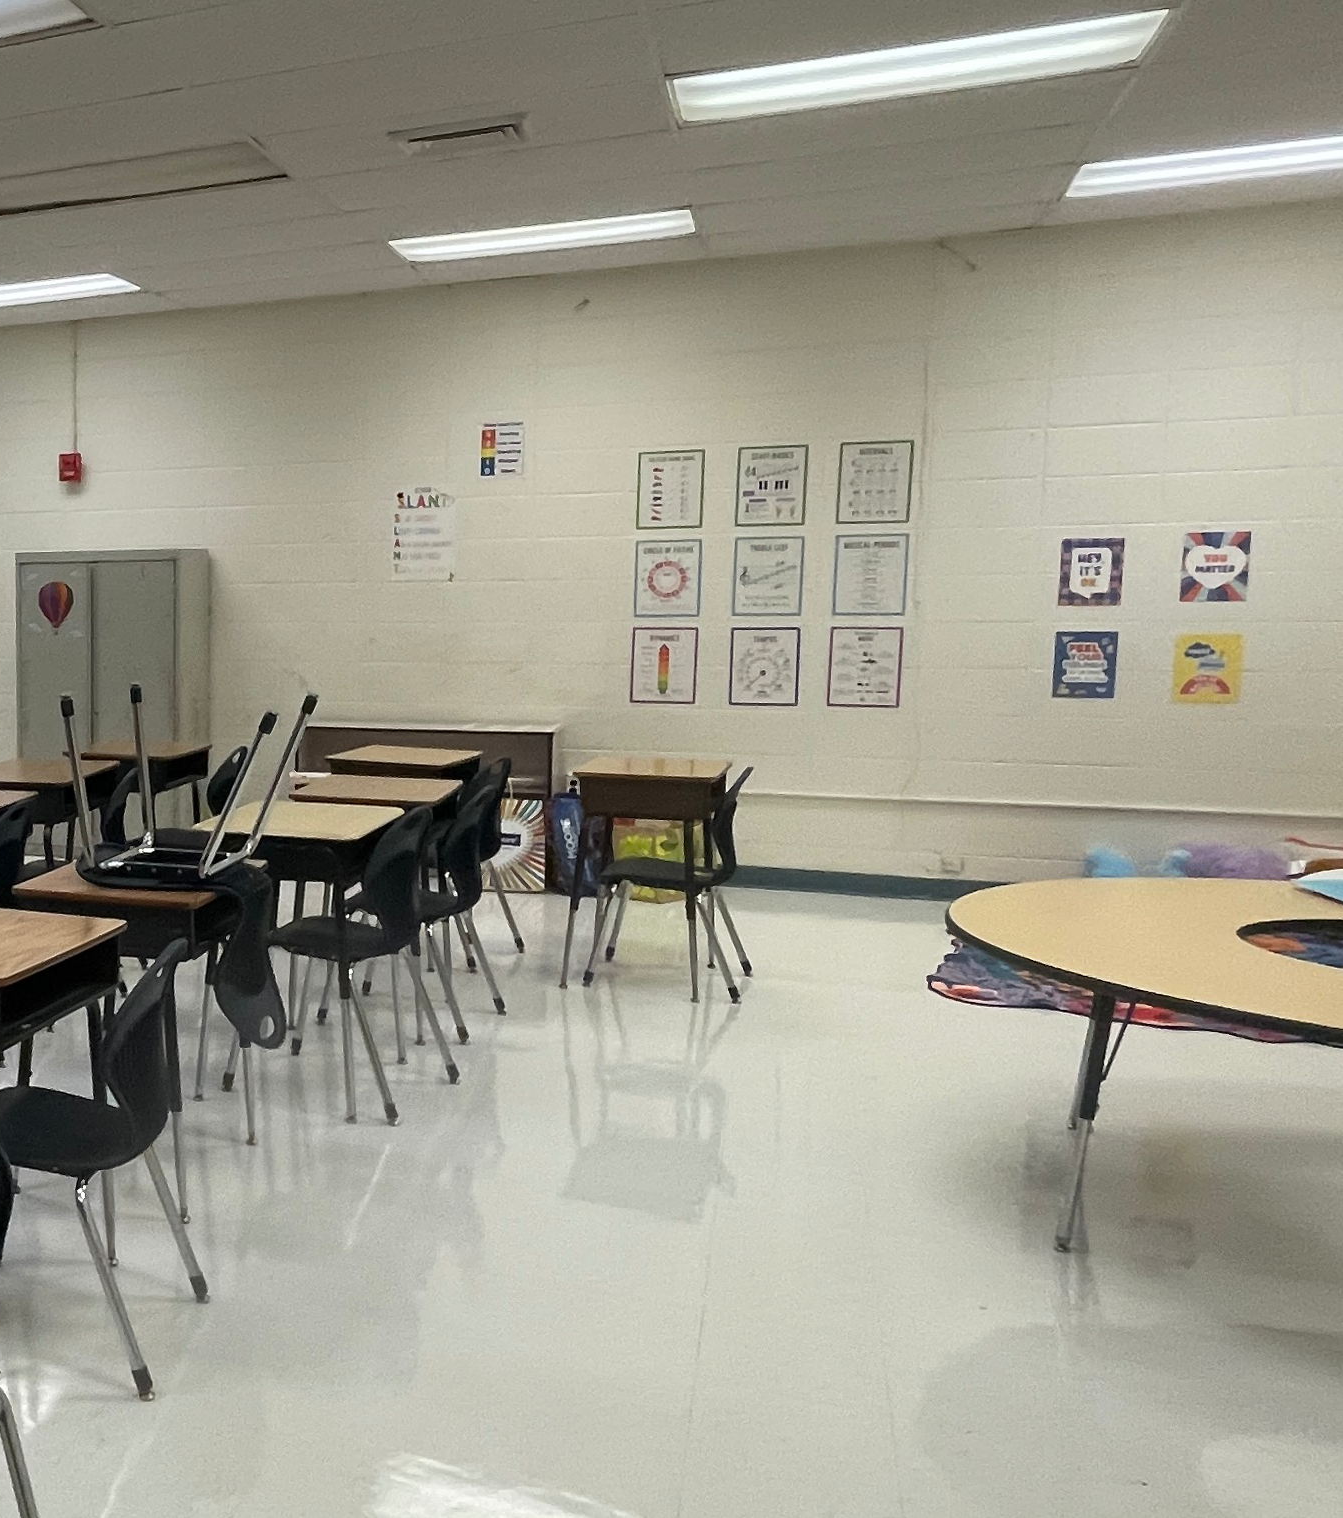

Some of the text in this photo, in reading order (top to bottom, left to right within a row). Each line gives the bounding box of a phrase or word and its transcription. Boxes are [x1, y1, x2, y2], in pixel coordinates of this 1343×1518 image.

[1204, 553, 1228, 563] YOU
[1194, 565, 1236, 573] MATTER
[1069, 643, 1099, 653] FEEL
